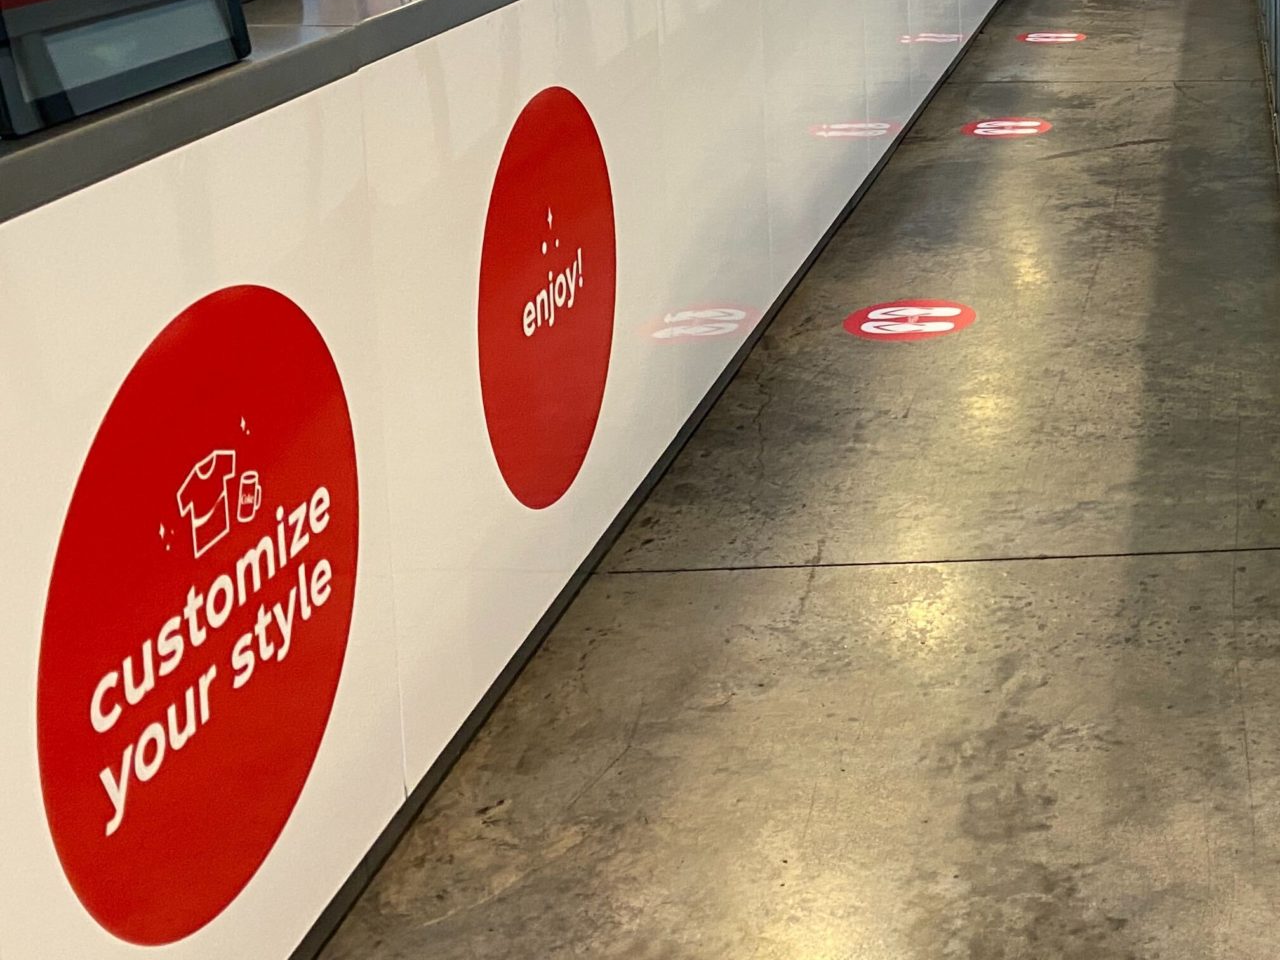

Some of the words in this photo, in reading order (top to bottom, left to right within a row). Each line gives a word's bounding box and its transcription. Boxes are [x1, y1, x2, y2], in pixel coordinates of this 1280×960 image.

[523, 247, 583, 337] enjoy!
[90, 486, 331, 733] customize
[99, 665, 217, 837] your
[230, 558, 332, 690] style
